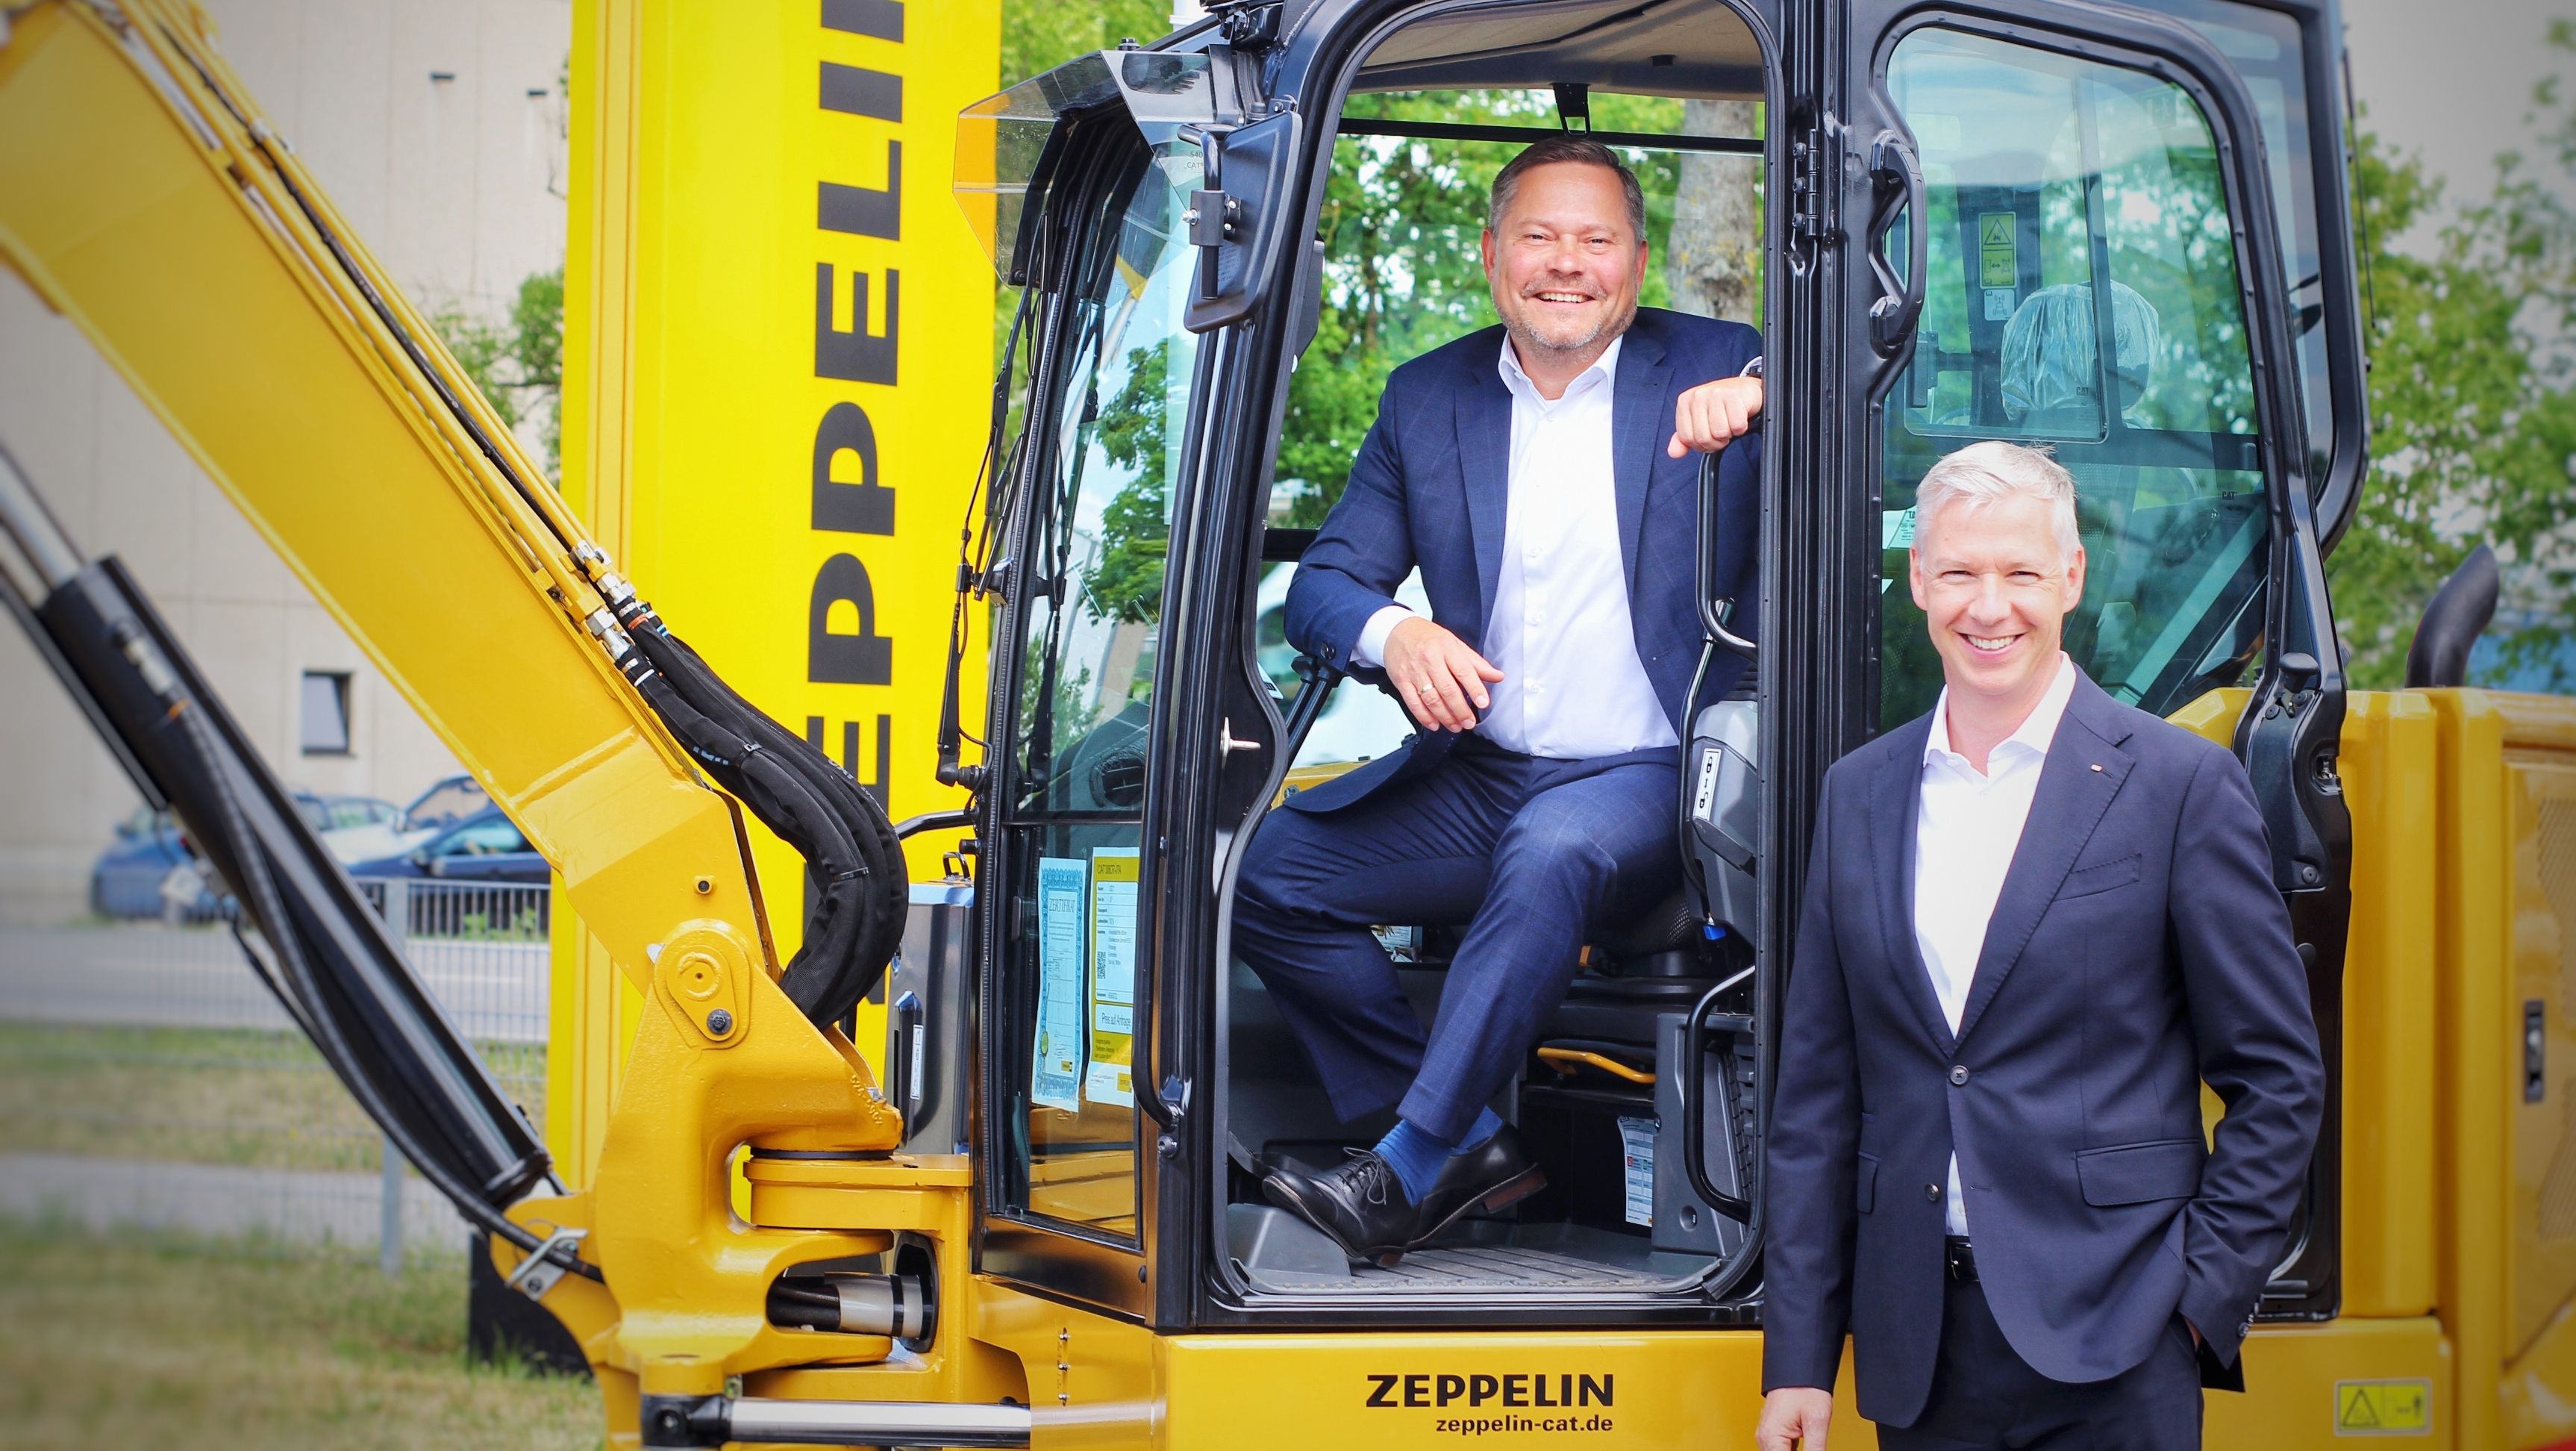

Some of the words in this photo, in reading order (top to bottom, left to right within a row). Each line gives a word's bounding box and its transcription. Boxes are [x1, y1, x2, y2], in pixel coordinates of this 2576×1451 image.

[804, 0, 905, 1004] EPPELI
[1049, 898, 1075, 912] ZERTIFIKAT
[1366, 1374, 1613, 1407] ZEPPELIN
[1436, 1415, 1613, 1435] zeppelin-cat.de
